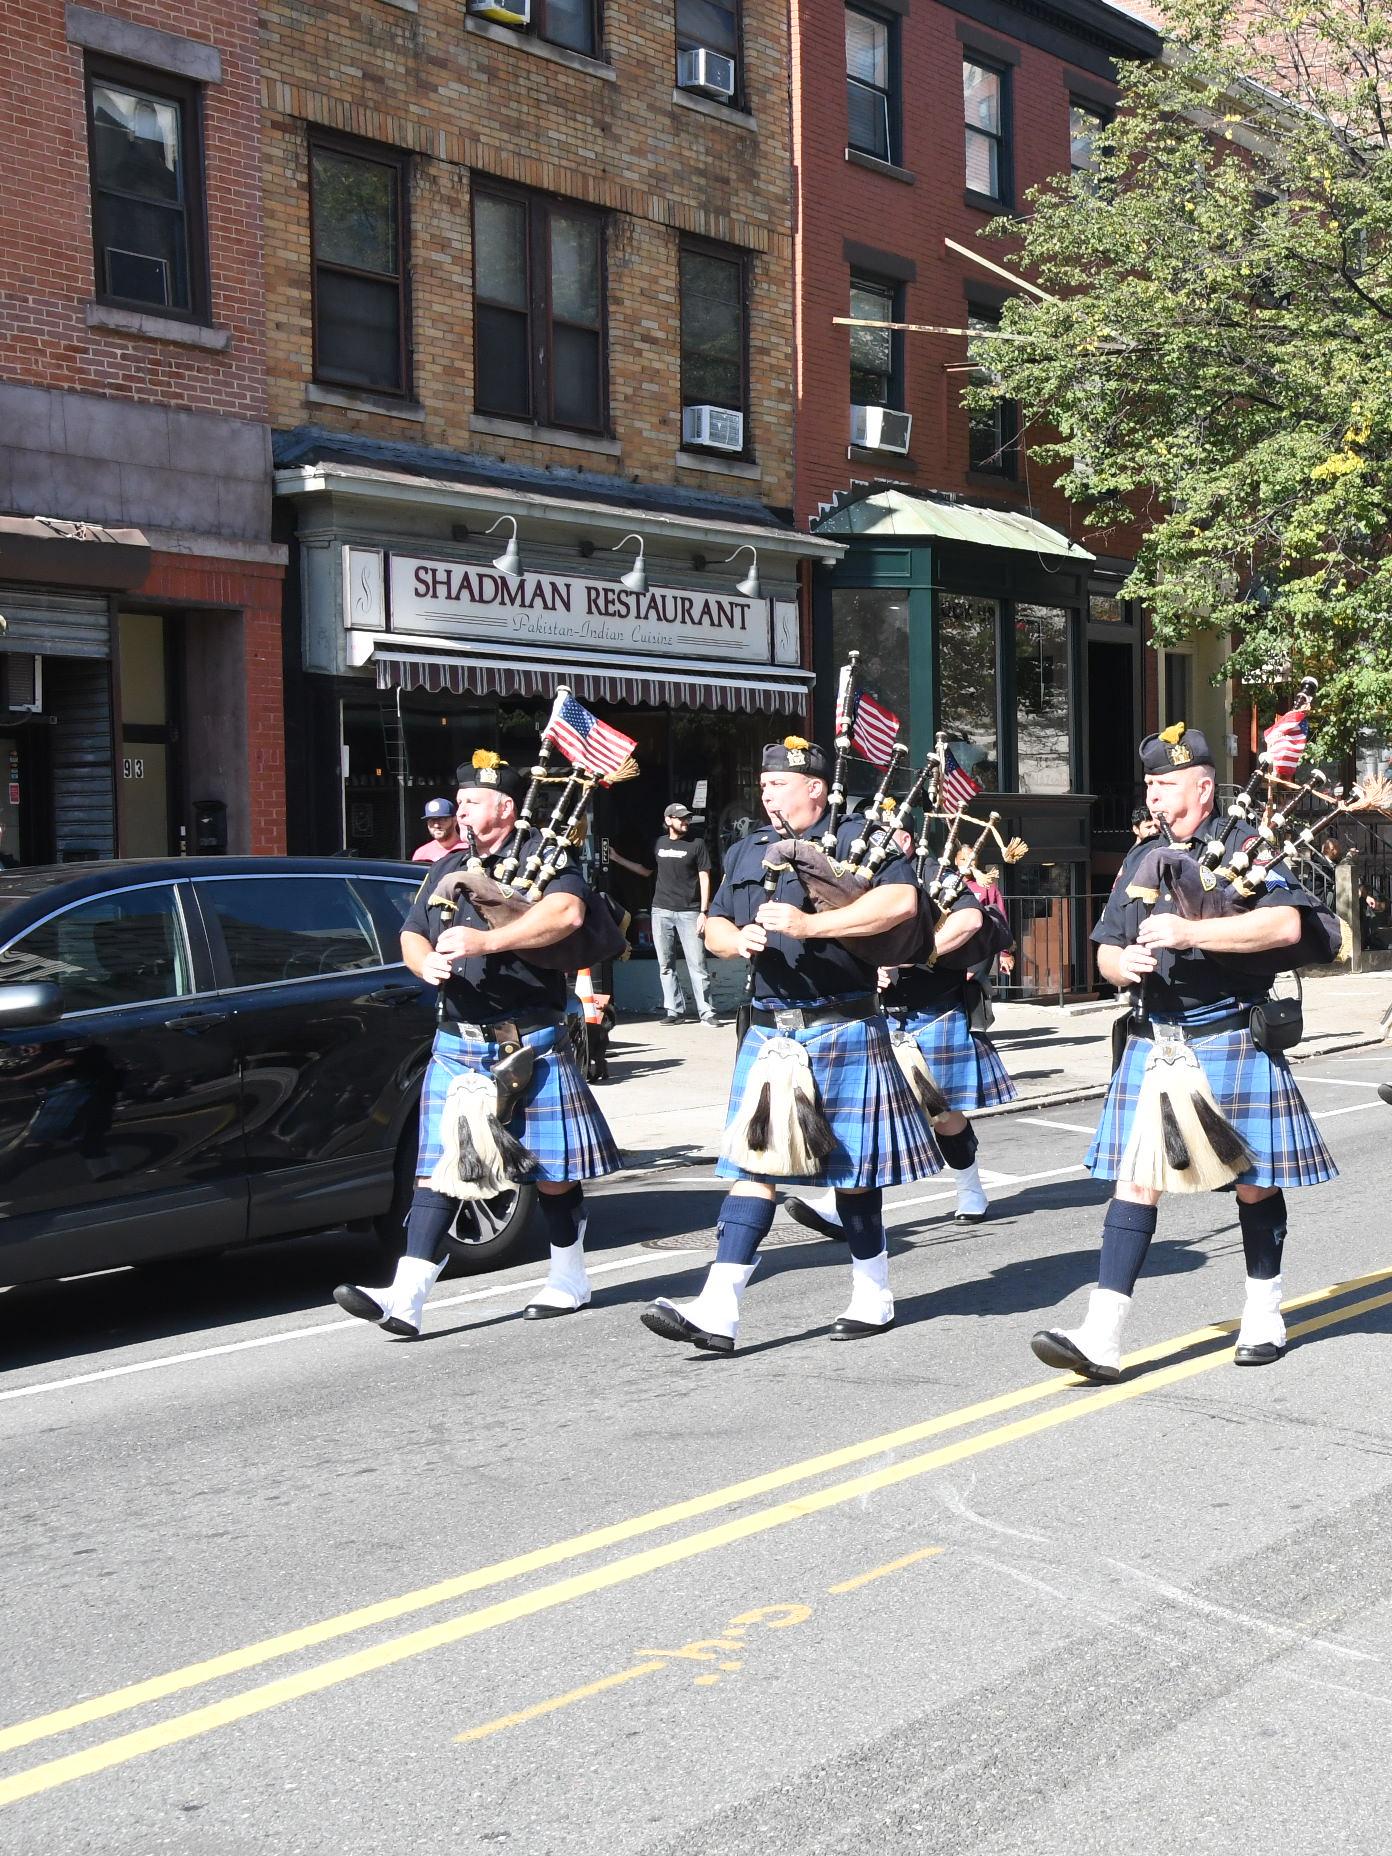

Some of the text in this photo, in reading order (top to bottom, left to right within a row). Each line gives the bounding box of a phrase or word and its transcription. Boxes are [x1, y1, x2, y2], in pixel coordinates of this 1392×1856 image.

[414, 565, 750, 630] SHADMAN RESTAURANT
[512, 612, 673, 646] Pakistan-Indian Cuisine
[124, 759, 143, 778] 93
